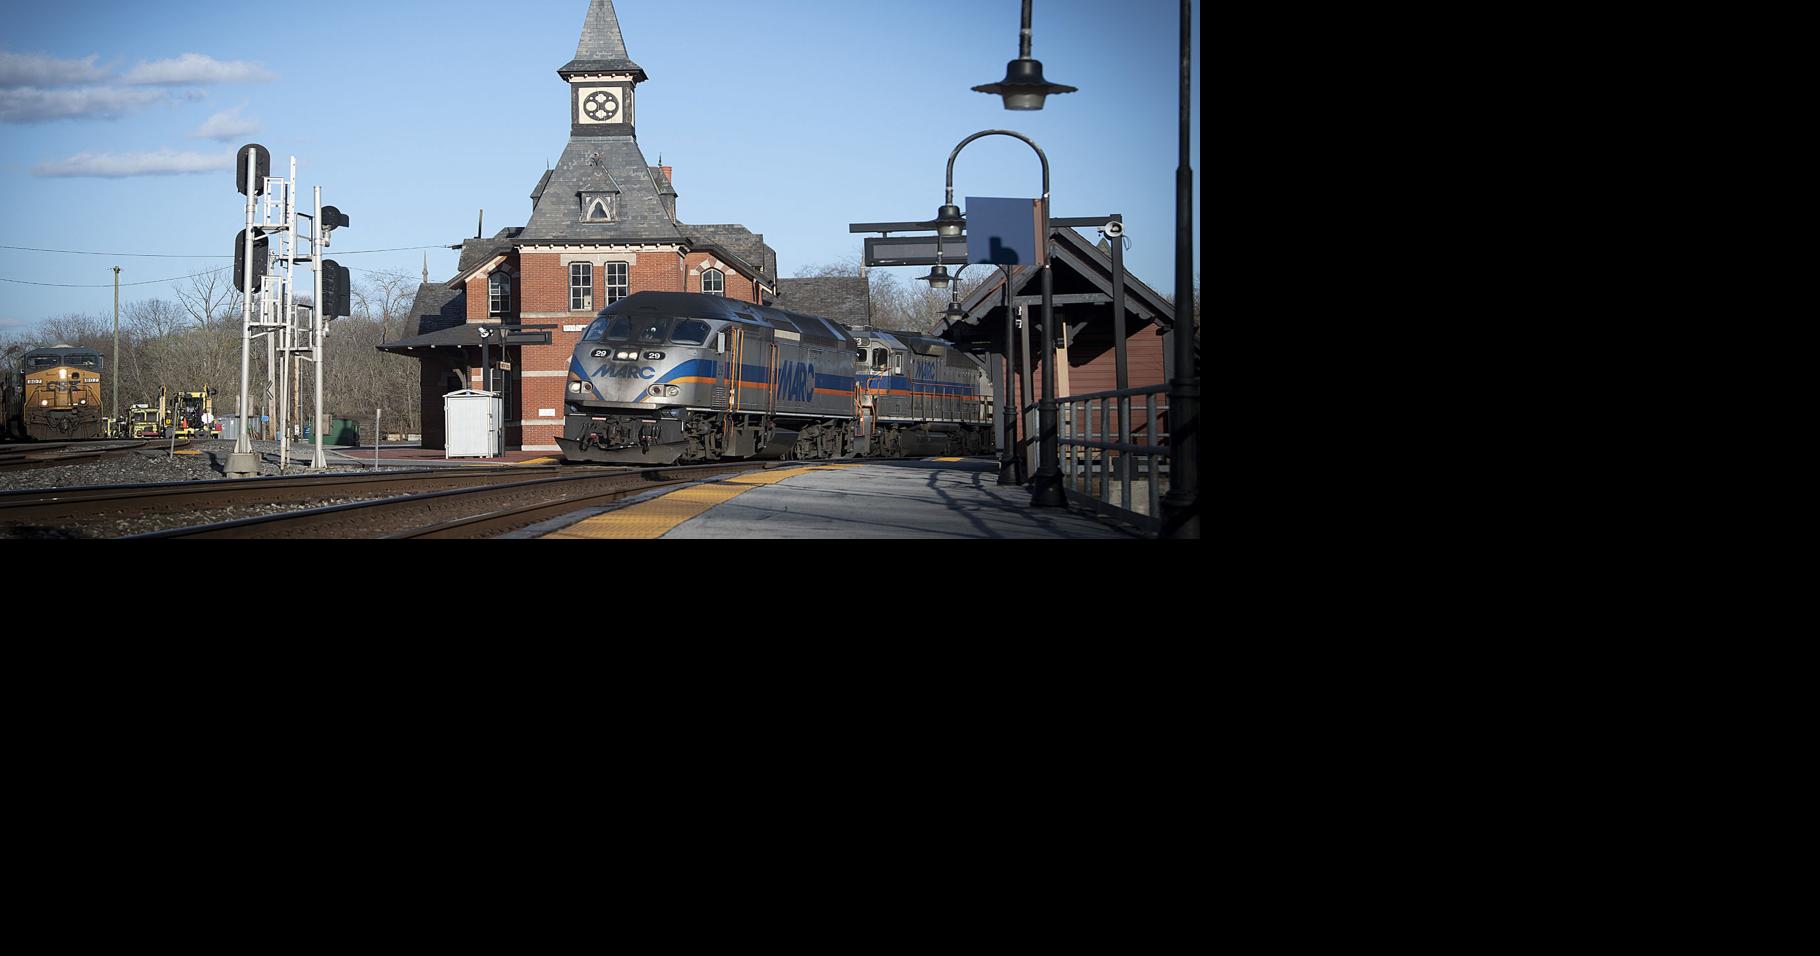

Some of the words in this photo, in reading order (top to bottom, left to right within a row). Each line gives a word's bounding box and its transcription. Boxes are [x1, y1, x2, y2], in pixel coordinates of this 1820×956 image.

[648, 352, 661, 360] 29
[591, 363, 656, 380] MARC
[777, 360, 815, 402] MARC
